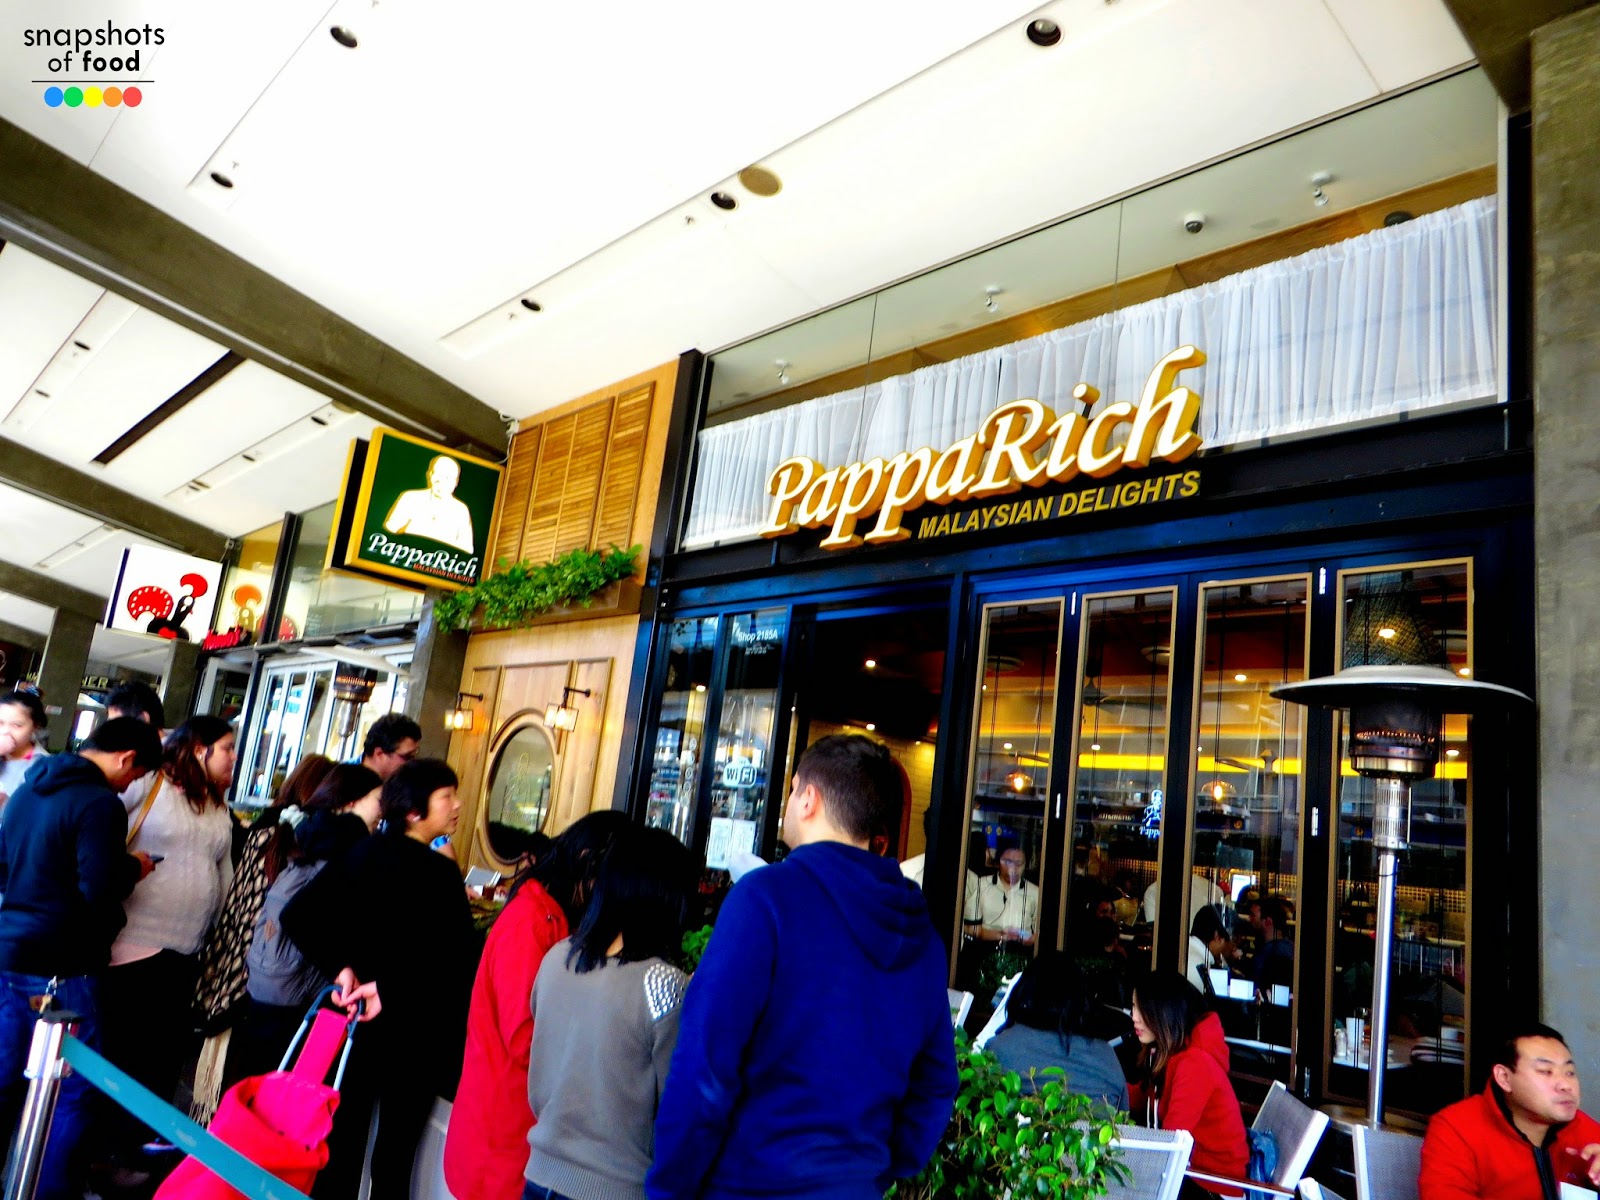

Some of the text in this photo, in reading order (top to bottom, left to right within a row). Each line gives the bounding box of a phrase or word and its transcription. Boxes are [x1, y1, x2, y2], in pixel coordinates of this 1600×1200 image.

[759, 344, 1206, 550] PappaRich
[917, 470, 1201, 540] MALAYSIAN DELIGHTS
[367, 532, 479, 577] PappaRich
